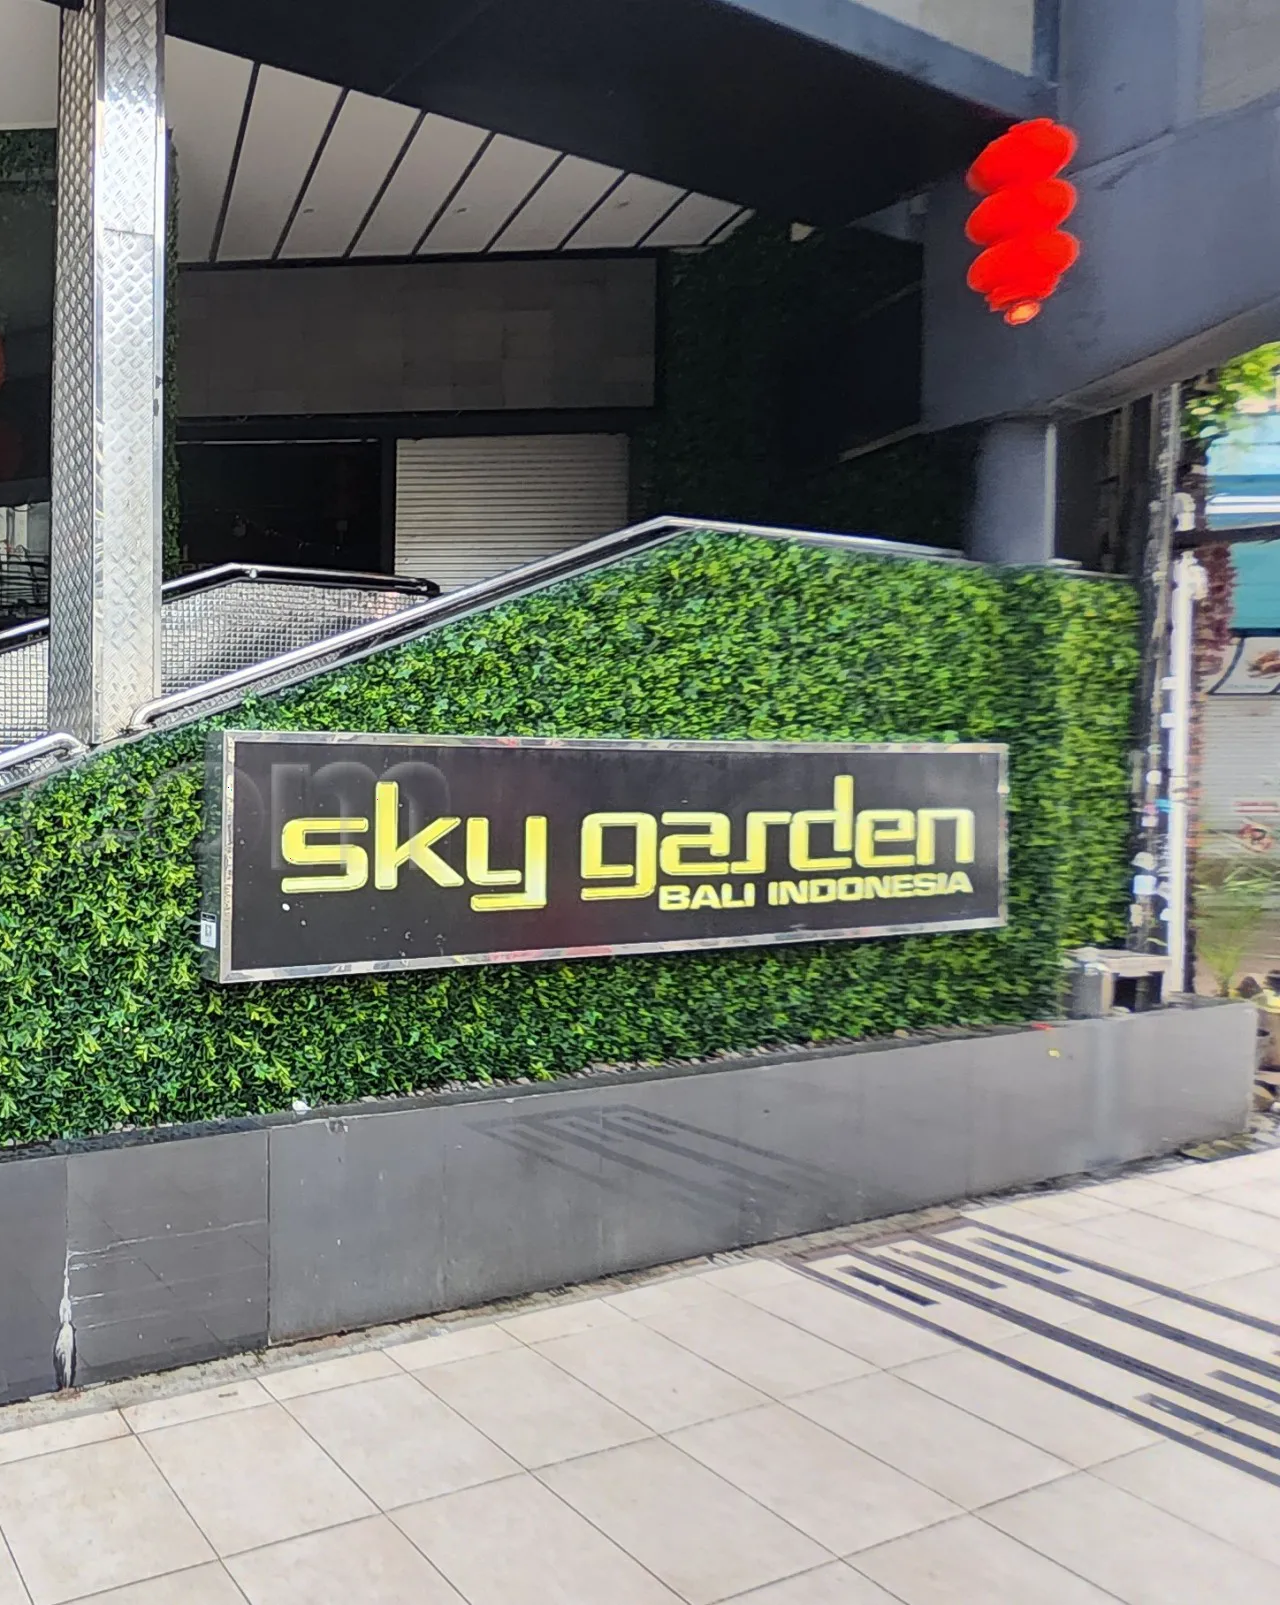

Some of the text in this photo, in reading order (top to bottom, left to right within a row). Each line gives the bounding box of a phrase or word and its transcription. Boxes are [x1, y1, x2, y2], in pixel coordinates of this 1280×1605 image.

[281, 774, 975, 912] sky garden
[658, 871, 974, 911] BALI INDONESIA
